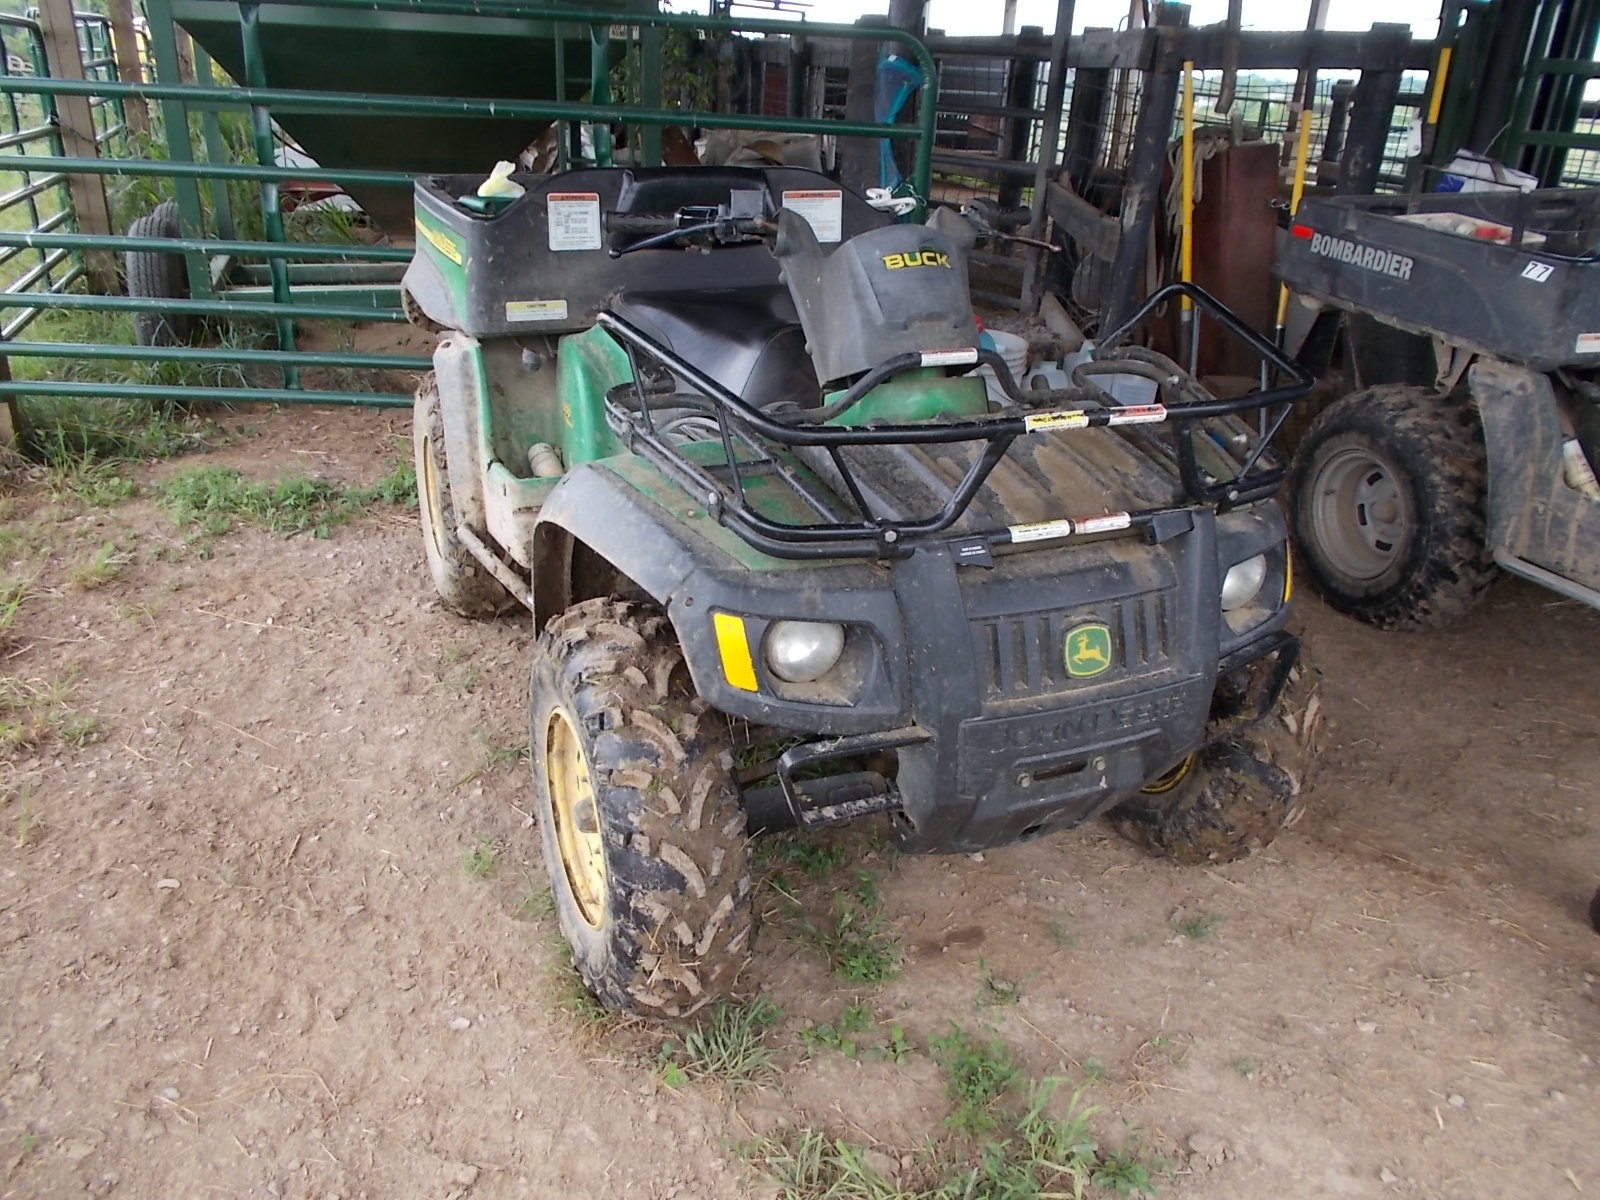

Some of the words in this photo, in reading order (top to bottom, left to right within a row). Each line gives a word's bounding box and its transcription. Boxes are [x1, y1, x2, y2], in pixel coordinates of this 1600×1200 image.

[882, 250, 952, 271] BUCK
[1310, 232, 1416, 280] BOMBARDIER
[1524, 262, 1551, 280] 77
